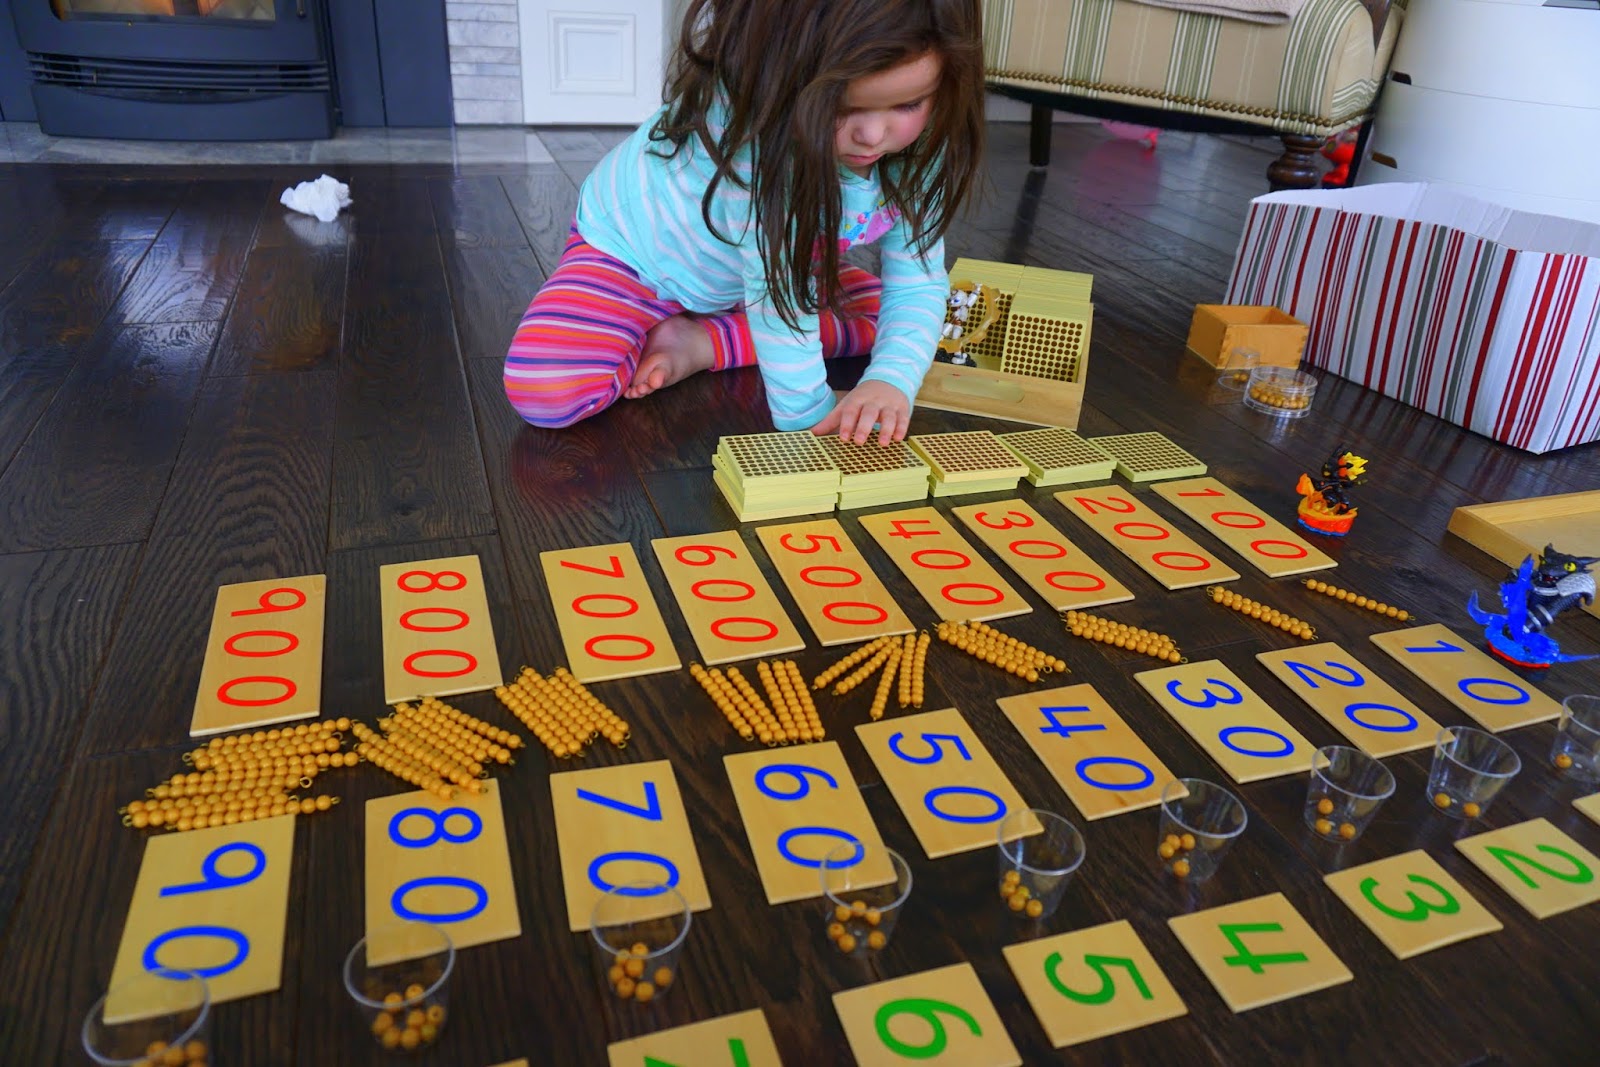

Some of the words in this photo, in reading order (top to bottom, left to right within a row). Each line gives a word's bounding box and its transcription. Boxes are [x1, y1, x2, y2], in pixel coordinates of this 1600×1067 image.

[890, 520, 1004, 605] 400
[975, 512, 1105, 591] 300
[1076, 498, 1210, 571] 200
[1180, 489, 1307, 559] 100
[561, 556, 654, 661] 700
[675, 545, 778, 642] 600
[781, 534, 888, 625] 500
[217, 588, 306, 706] 900
[397, 571, 477, 678] 800
[1284, 661, 1418, 732] 20
[1406, 640, 1530, 705] 10
[1040, 706, 1154, 791] 40
[1167, 679, 1294, 758] 30
[755, 764, 864, 869] 60
[889, 733, 1007, 824] 50
[389, 807, 488, 924] 80
[577, 782, 679, 897] 70
[1487, 844, 1594, 889] 2
[143, 842, 266, 980] 90
[1360, 874, 1460, 922] 3
[1044, 952, 1153, 1005] 5
[1220, 923, 1308, 973] 4
[875, 998, 982, 1059] 6
